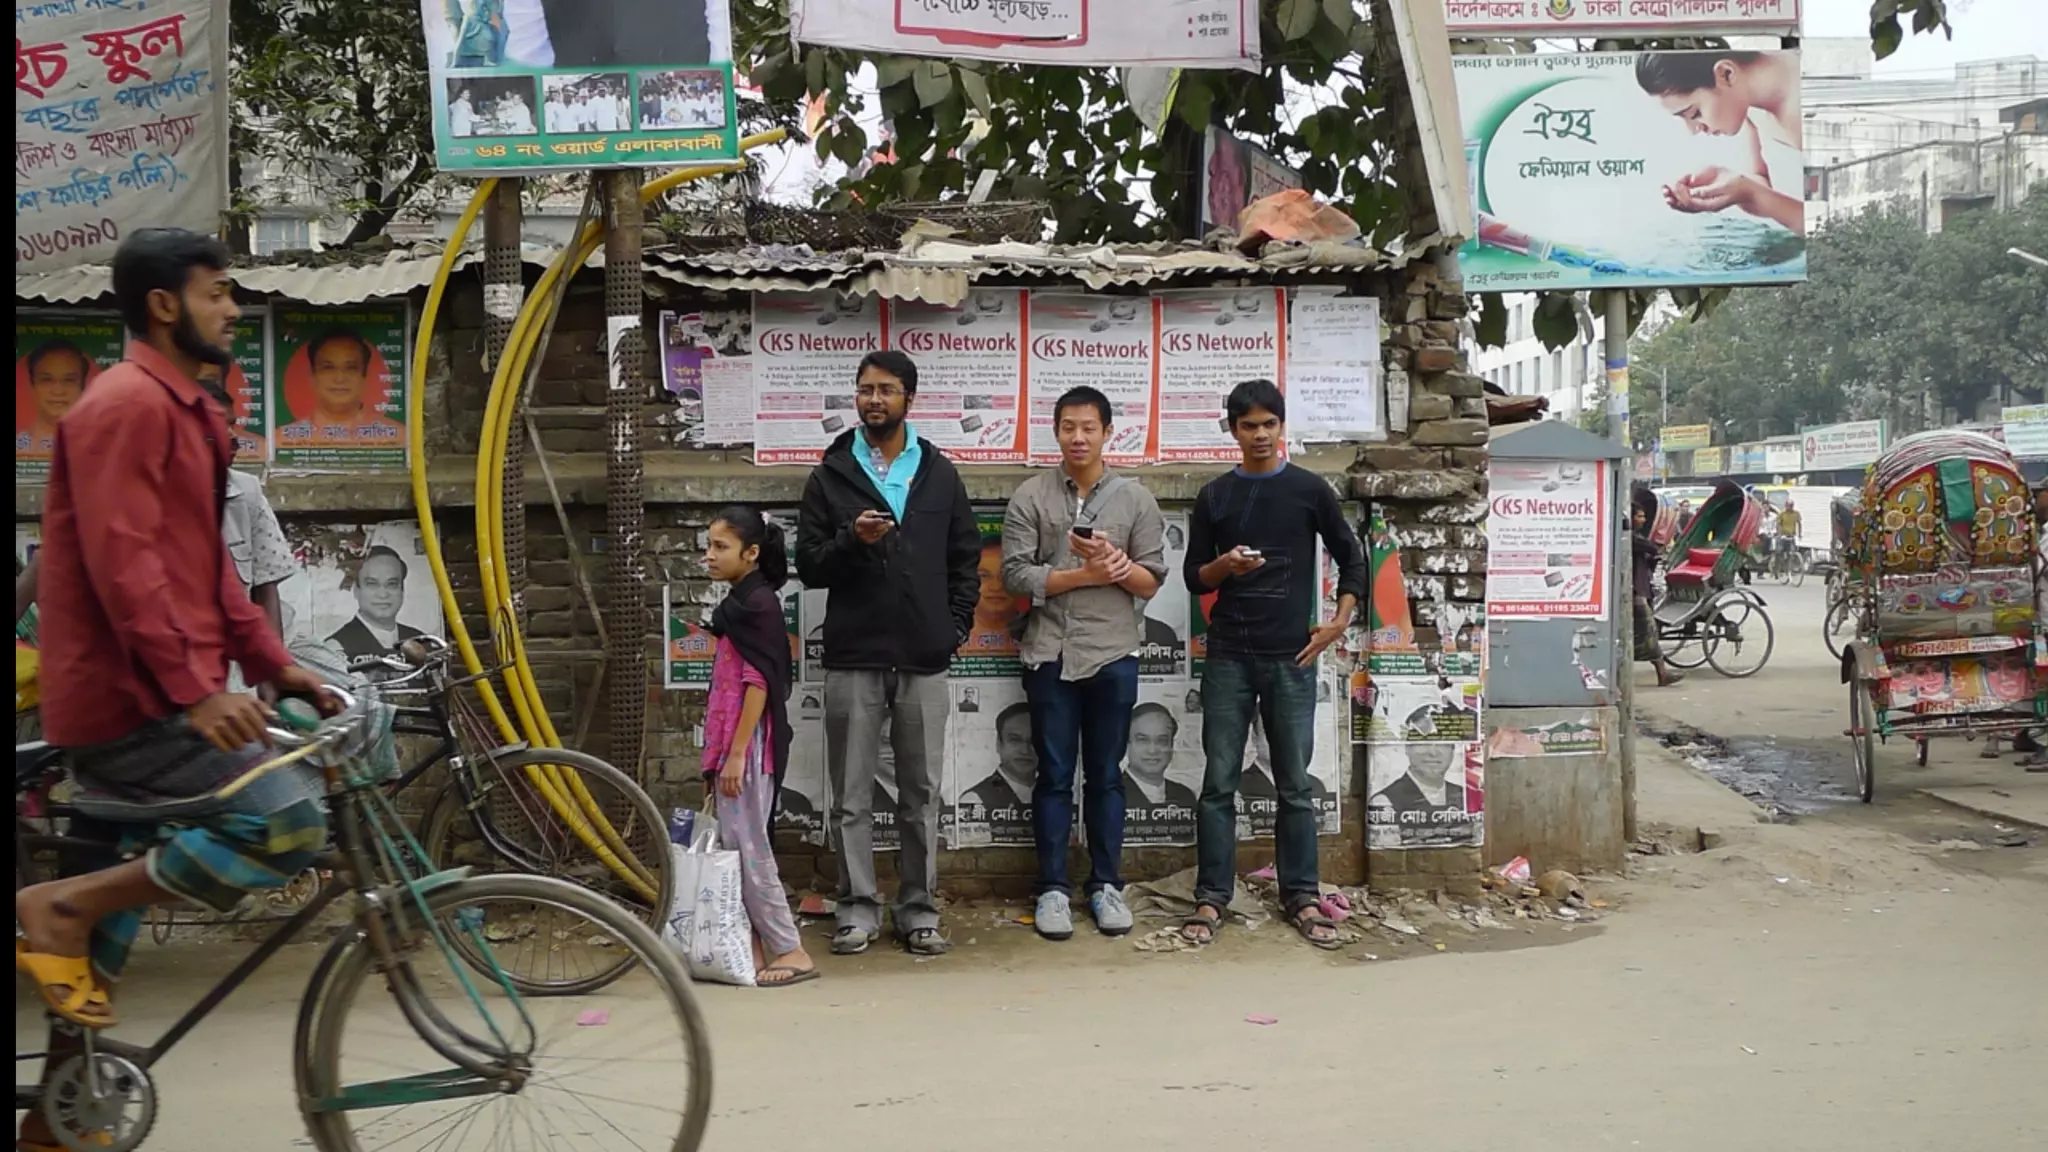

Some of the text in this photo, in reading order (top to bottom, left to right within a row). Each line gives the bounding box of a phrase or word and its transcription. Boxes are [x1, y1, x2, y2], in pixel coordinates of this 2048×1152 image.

[83, 14, 187, 84] স্কুল
[86, 126, 140, 158] বাংলা
[140, 111, 201, 157] মাধ্যম
[476, 143, 507, 158] ৬৪
[515, 141, 545, 158] নং
[549, 137, 608, 156] ওয়ার্ড
[614, 133, 725, 154] এলাকাবাসী
[1597, 159, 1645, 177] ওয়াশ
[16, 217, 118, 263] ১৬০৯৯০
[771, 331, 877, 352] KS Network
[911, 332, 1016, 351] KS Network
[1044, 339, 1148, 359] KS Network
[1170, 331, 1274, 352] KS Network
[1502, 498, 1594, 515] KS Network
[1151, 804, 1192, 822] সেলিম
[1400, 810, 1427, 824] মোঃ
